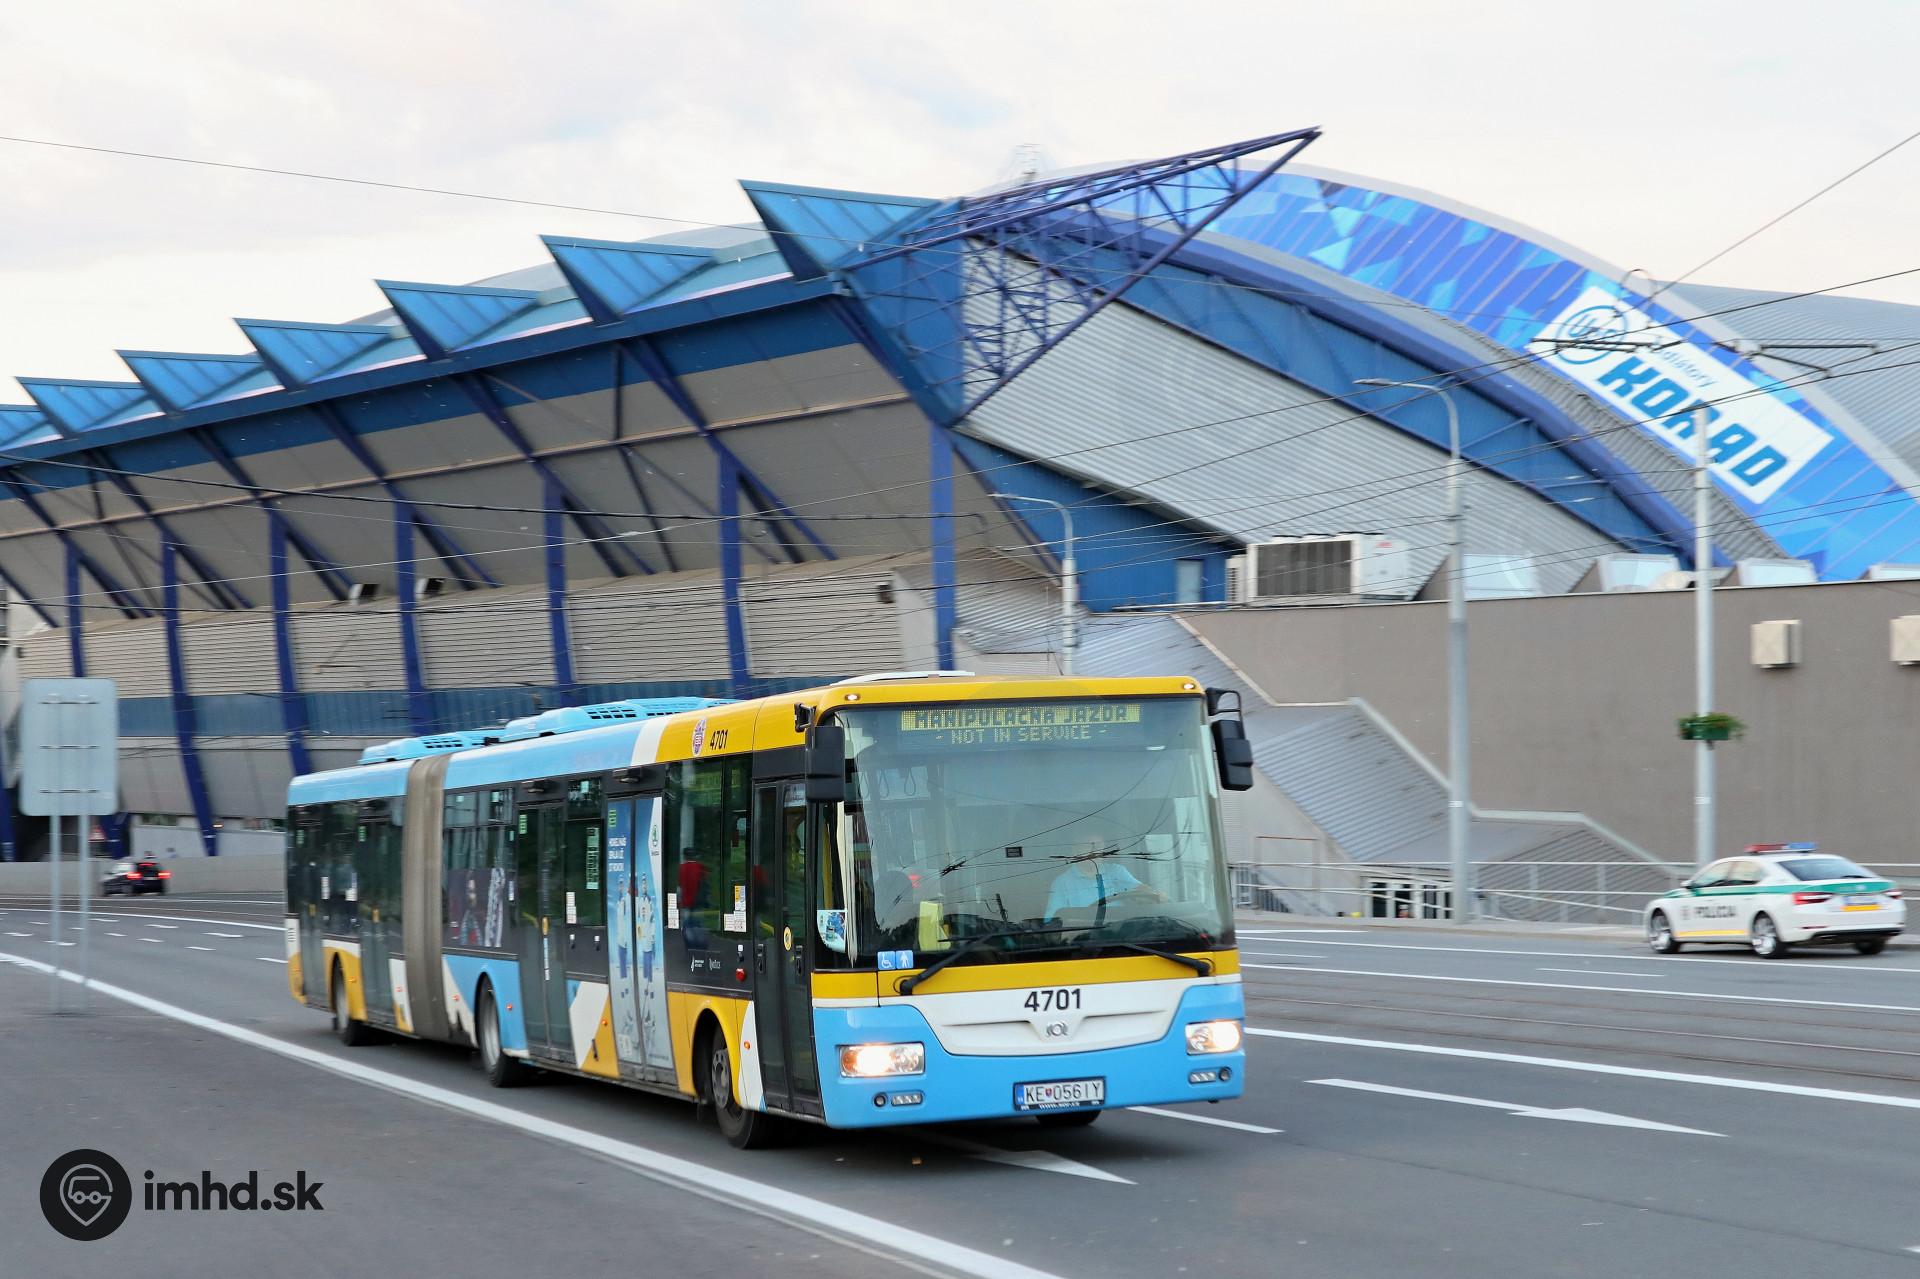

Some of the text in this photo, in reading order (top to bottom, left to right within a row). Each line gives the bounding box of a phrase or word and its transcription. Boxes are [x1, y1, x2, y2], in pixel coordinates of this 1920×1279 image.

[1597, 357, 1788, 487] KORAD
[710, 729, 729, 750] 4701
[951, 726, 1092, 744] NOT IN SERVICE
[1024, 988, 1082, 1012] 4701
[1025, 1087, 1045, 1102] KE
